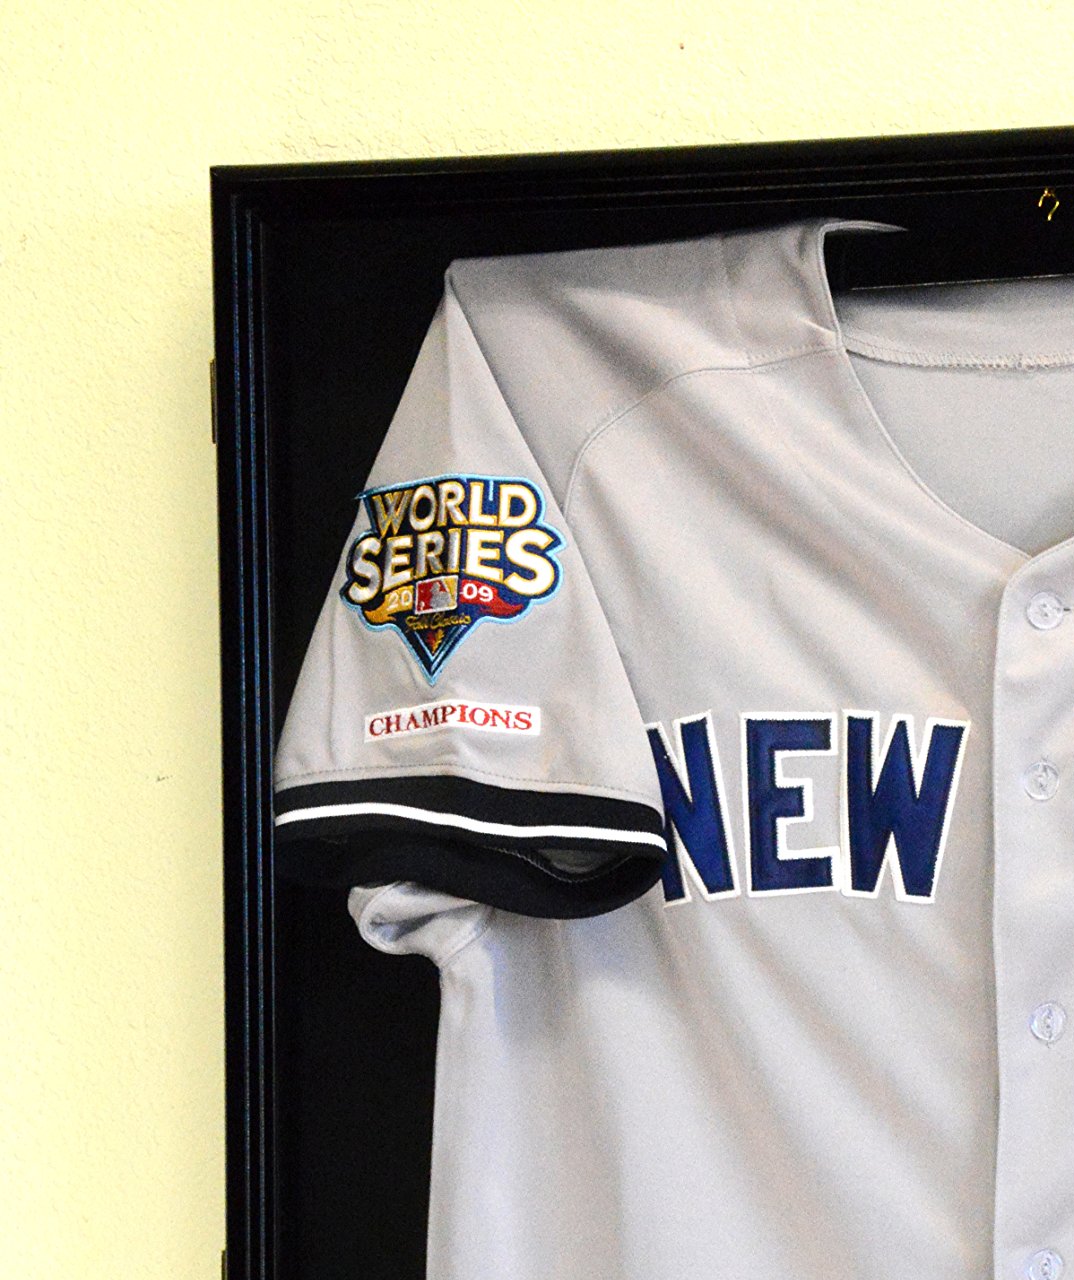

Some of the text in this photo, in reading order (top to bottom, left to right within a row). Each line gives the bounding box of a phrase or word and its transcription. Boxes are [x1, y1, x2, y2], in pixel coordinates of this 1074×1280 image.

[372, 481, 537, 536] WORLD
[349, 528, 556, 604] SERIES
[462, 583, 494, 603] 09
[369, 704, 532, 736] CHAMPIONS
[646, 708, 970, 905] NEW
